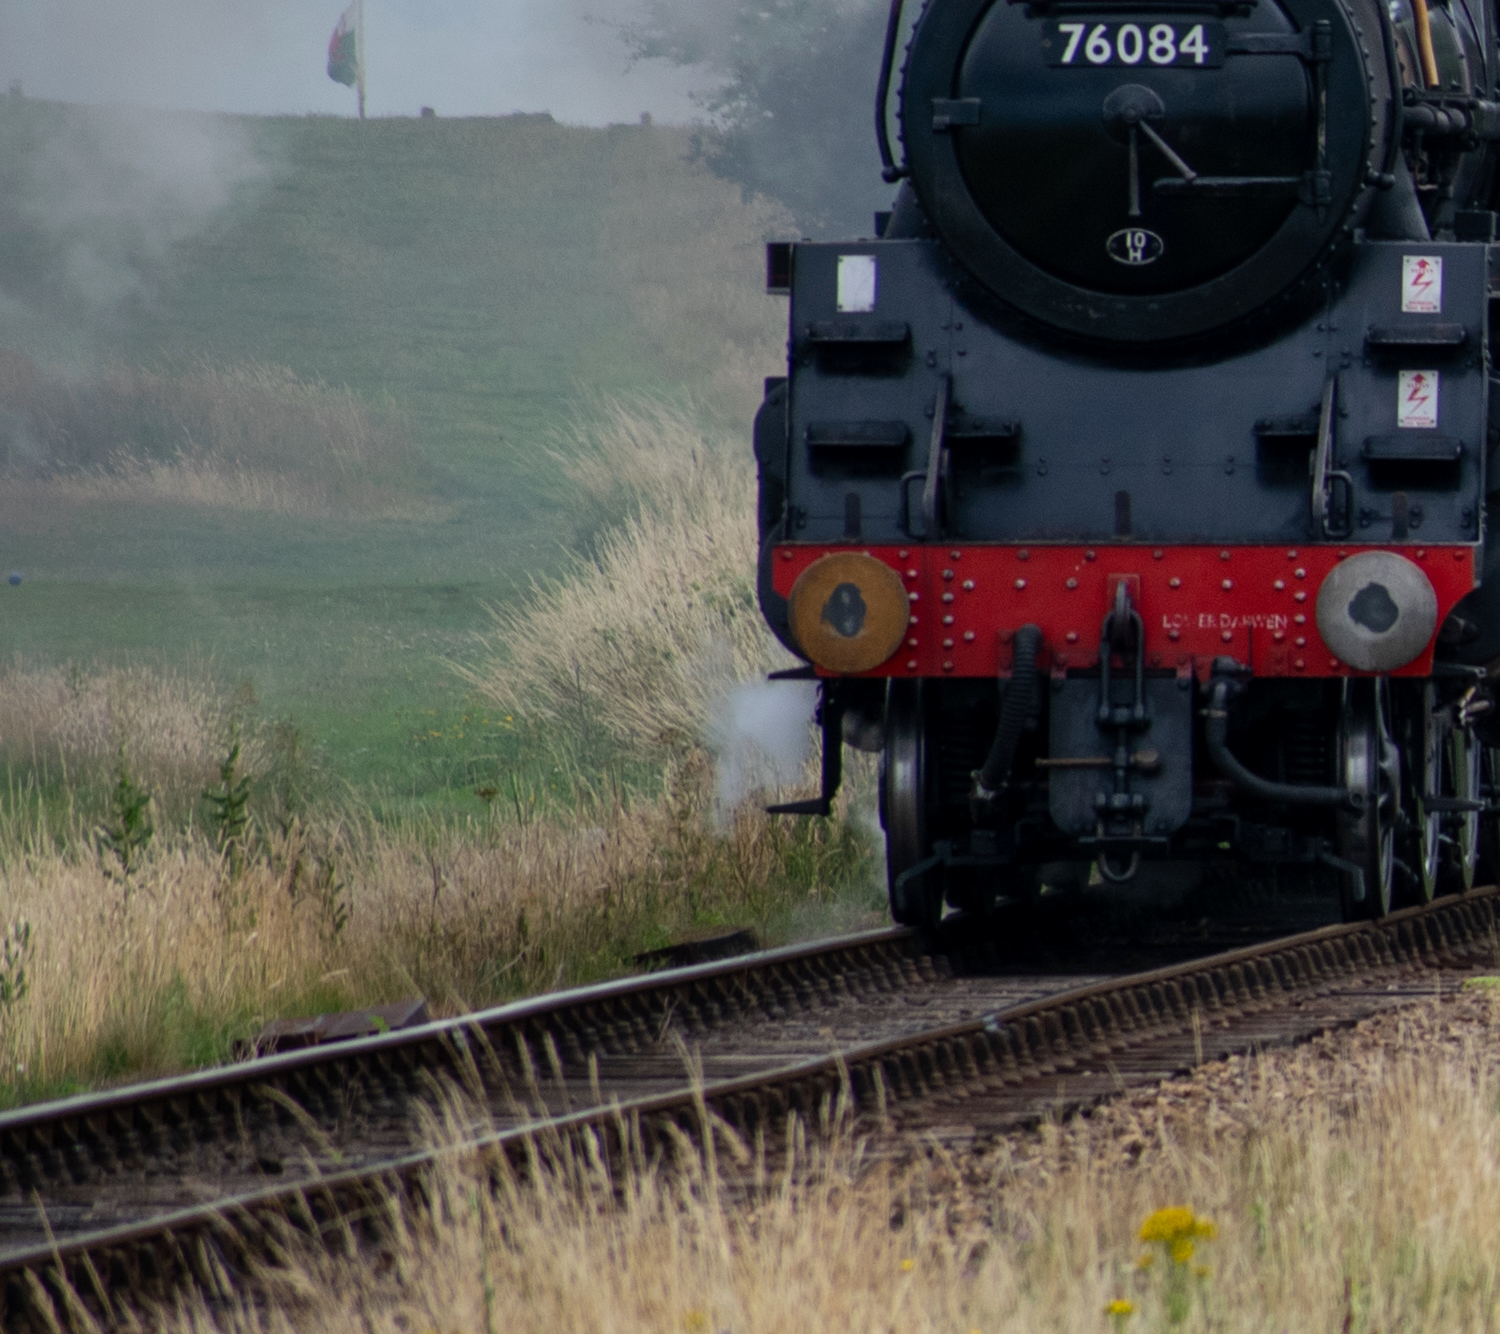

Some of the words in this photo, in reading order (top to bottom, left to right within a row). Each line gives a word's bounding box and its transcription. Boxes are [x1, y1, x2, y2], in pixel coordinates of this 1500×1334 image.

[1058, 23, 1211, 64] 76084
[1126, 231, 1146, 248] 10
[1129, 248, 1142, 262] H
